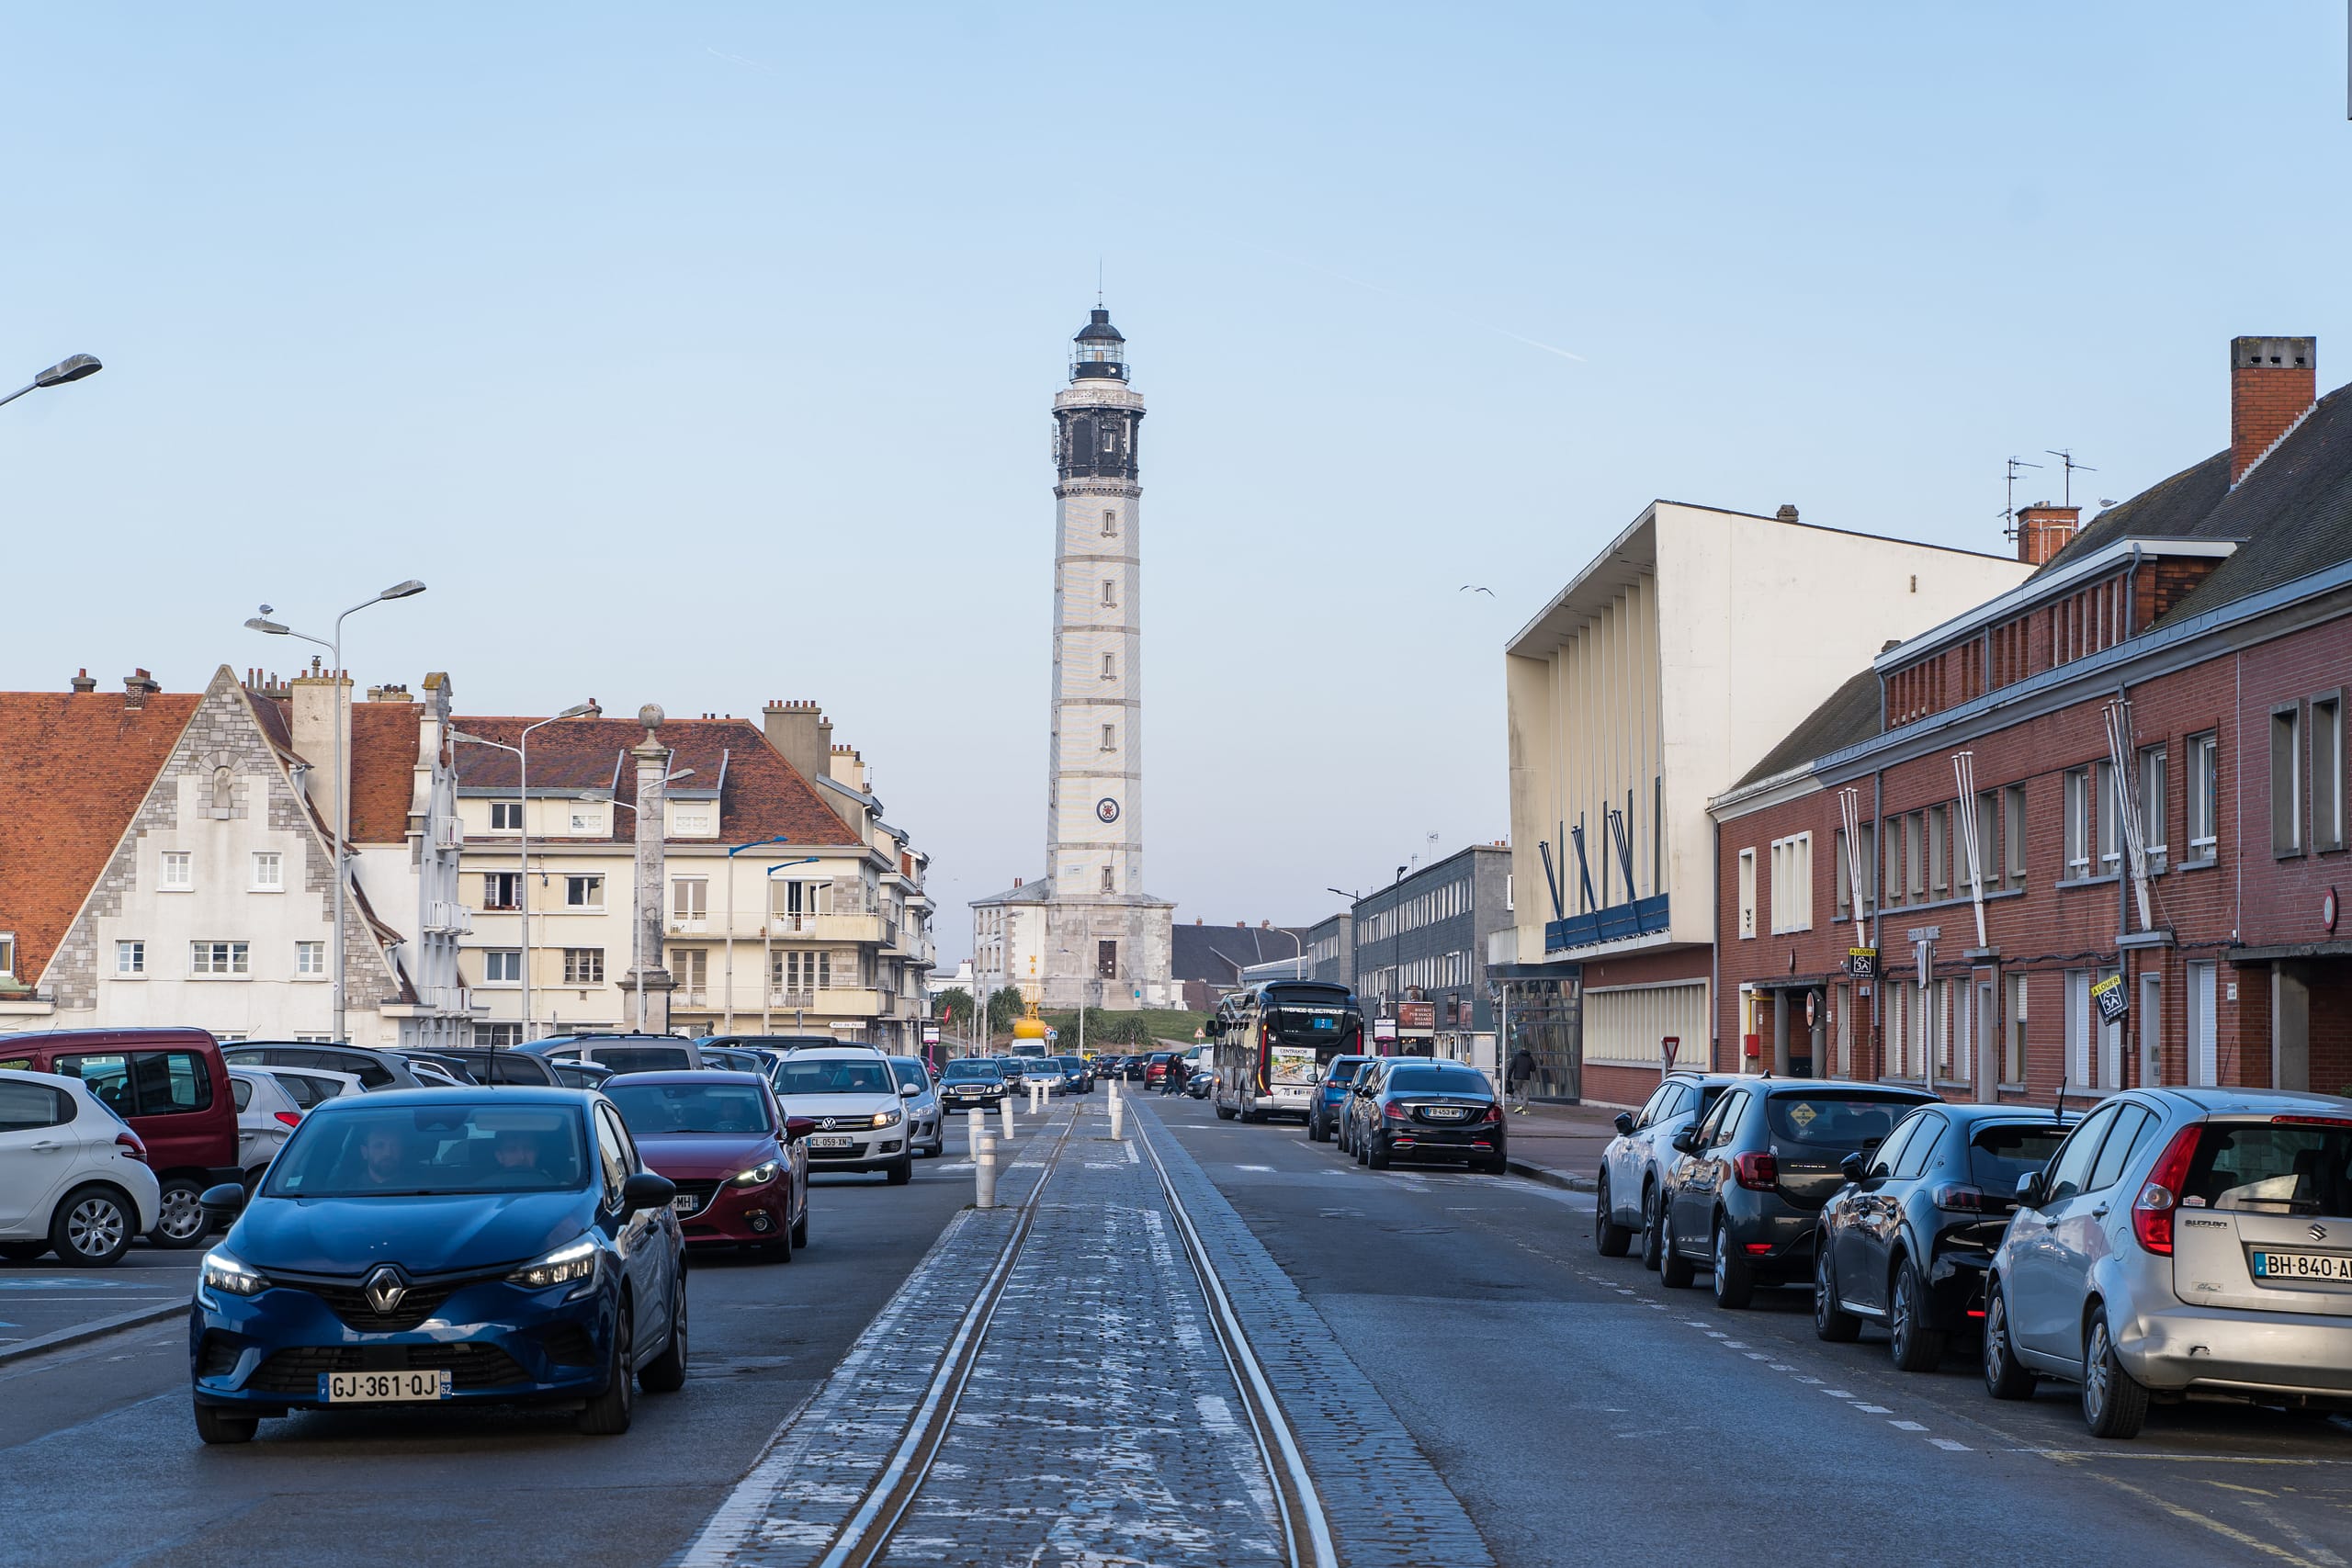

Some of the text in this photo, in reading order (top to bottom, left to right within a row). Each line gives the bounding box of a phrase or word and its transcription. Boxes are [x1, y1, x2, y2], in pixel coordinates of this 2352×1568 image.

[2098, 977, 2119, 991] LOUER
[2185, 1219, 2227, 1230] SUZUKI
[2268, 1256, 2352, 1279] BH-840-A
[333, 1374, 435, 1397] GJ-361-QJ
[441, 1384, 452, 1394] 62
